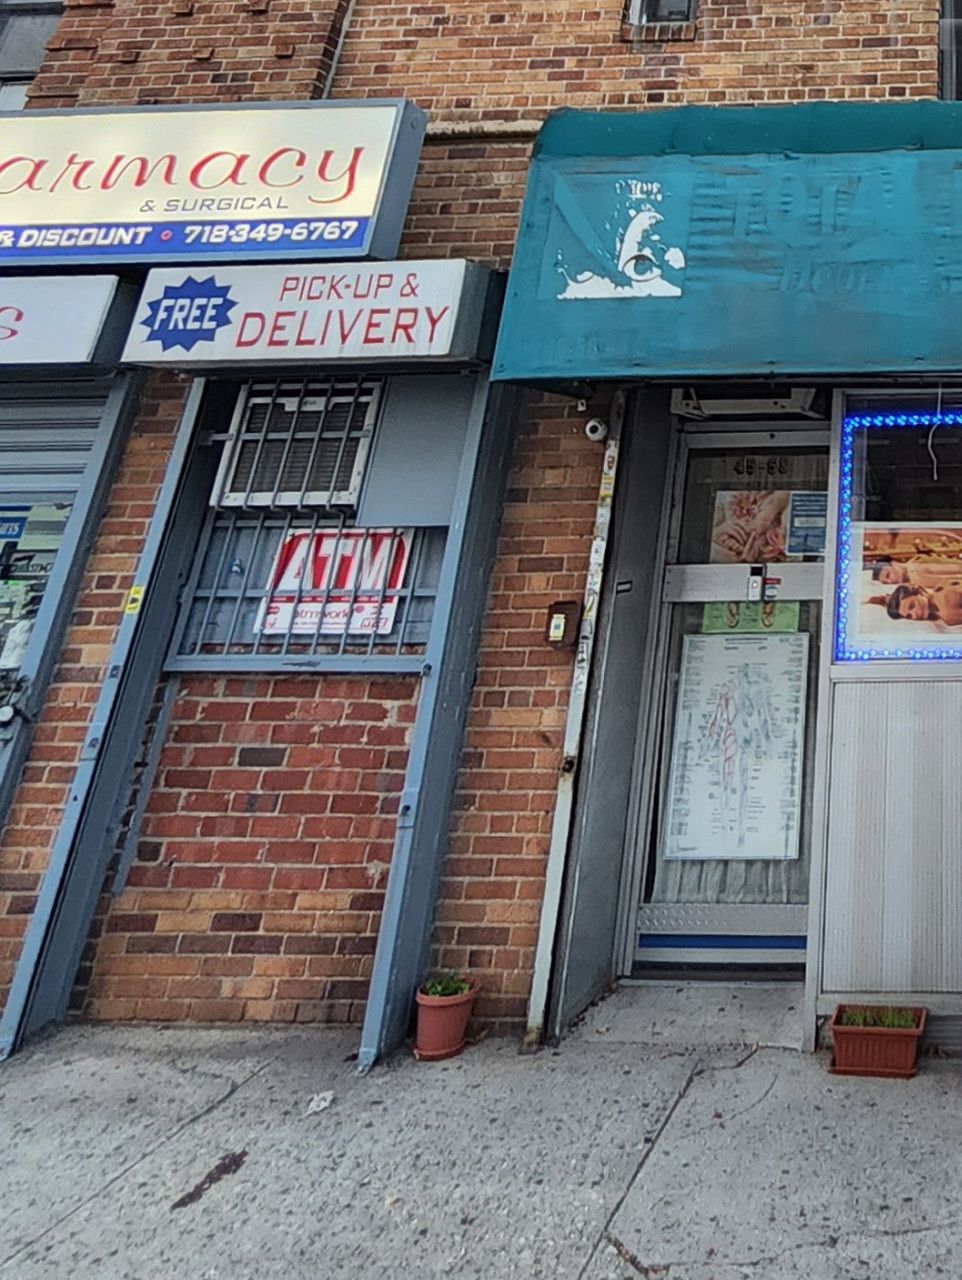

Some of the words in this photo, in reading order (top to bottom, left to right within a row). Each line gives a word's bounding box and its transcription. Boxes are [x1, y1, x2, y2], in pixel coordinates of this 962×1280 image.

[140, 199, 156, 212] &
[163, 196, 289, 212] SURGICAL
[17, 227, 152, 247] DISCOUNT
[184, 221, 359, 243] 718-349-6767
[279, 274, 393, 302] PICK-UP
[400, 273, 419, 297] &
[154, 297, 218, 331] FREE
[235, 306, 451, 348] DELIVERY
[275, 535, 394, 591] ATM
